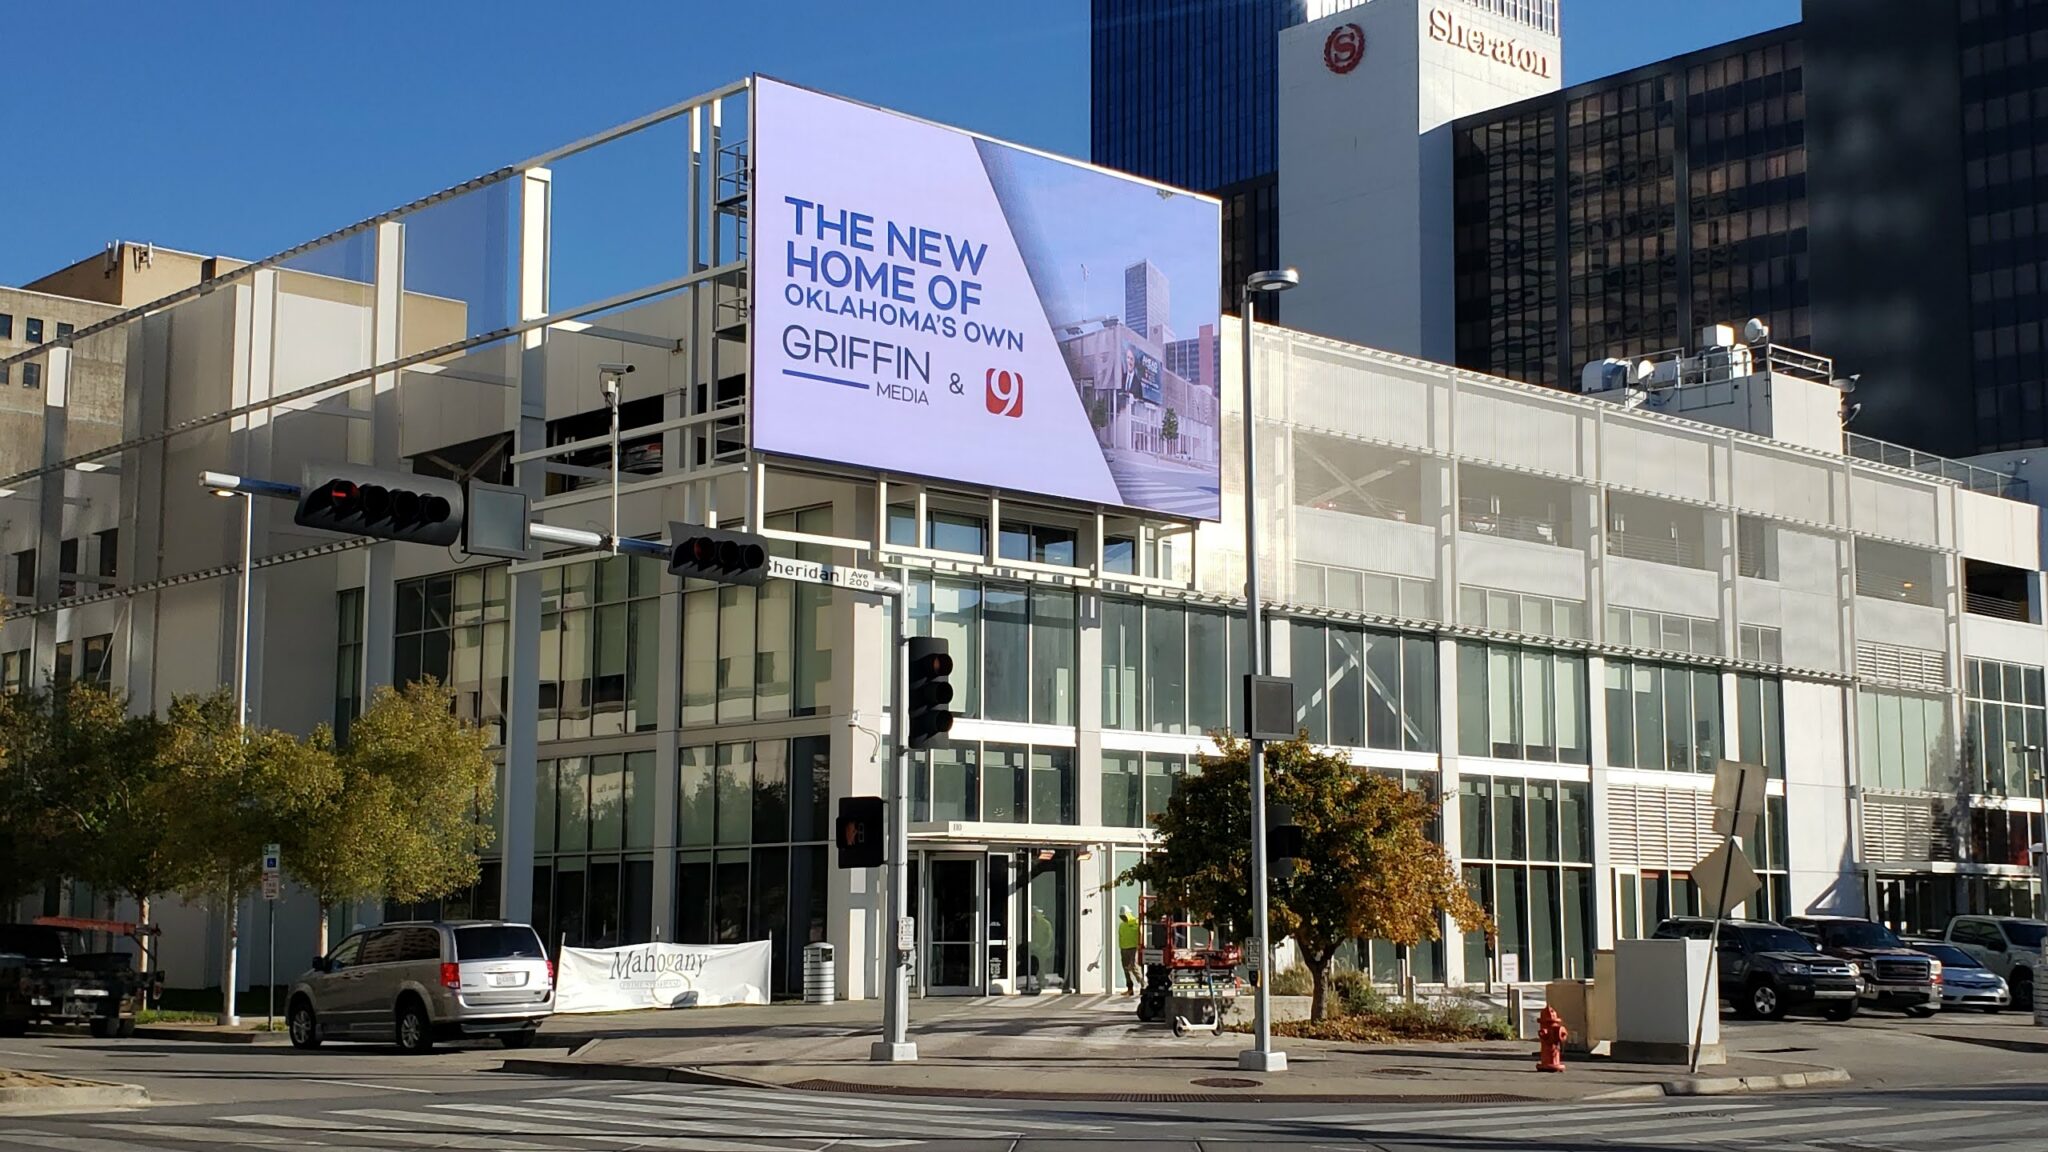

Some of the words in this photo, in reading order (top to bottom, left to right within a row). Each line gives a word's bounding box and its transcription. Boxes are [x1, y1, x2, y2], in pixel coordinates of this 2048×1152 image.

[1429, 7, 1551, 79] Sheraton
[785, 195, 874, 252] THE
[887, 220, 988, 276] NEW
[787, 240, 915, 304] HOME
[928, 274, 982, 315] OF
[784, 283, 957, 338] OKLAHOMA'S
[963, 321, 1023, 352] OWN
[782, 324, 930, 384] GRIFFIN
[876, 381, 929, 406] MEDIA
[949, 372, 965, 396] &
[989, 367, 1021, 417] 9
[849, 578, 870, 588] 200
[851, 571, 868, 580] Ave
[608, 947, 707, 979] Mahogany
